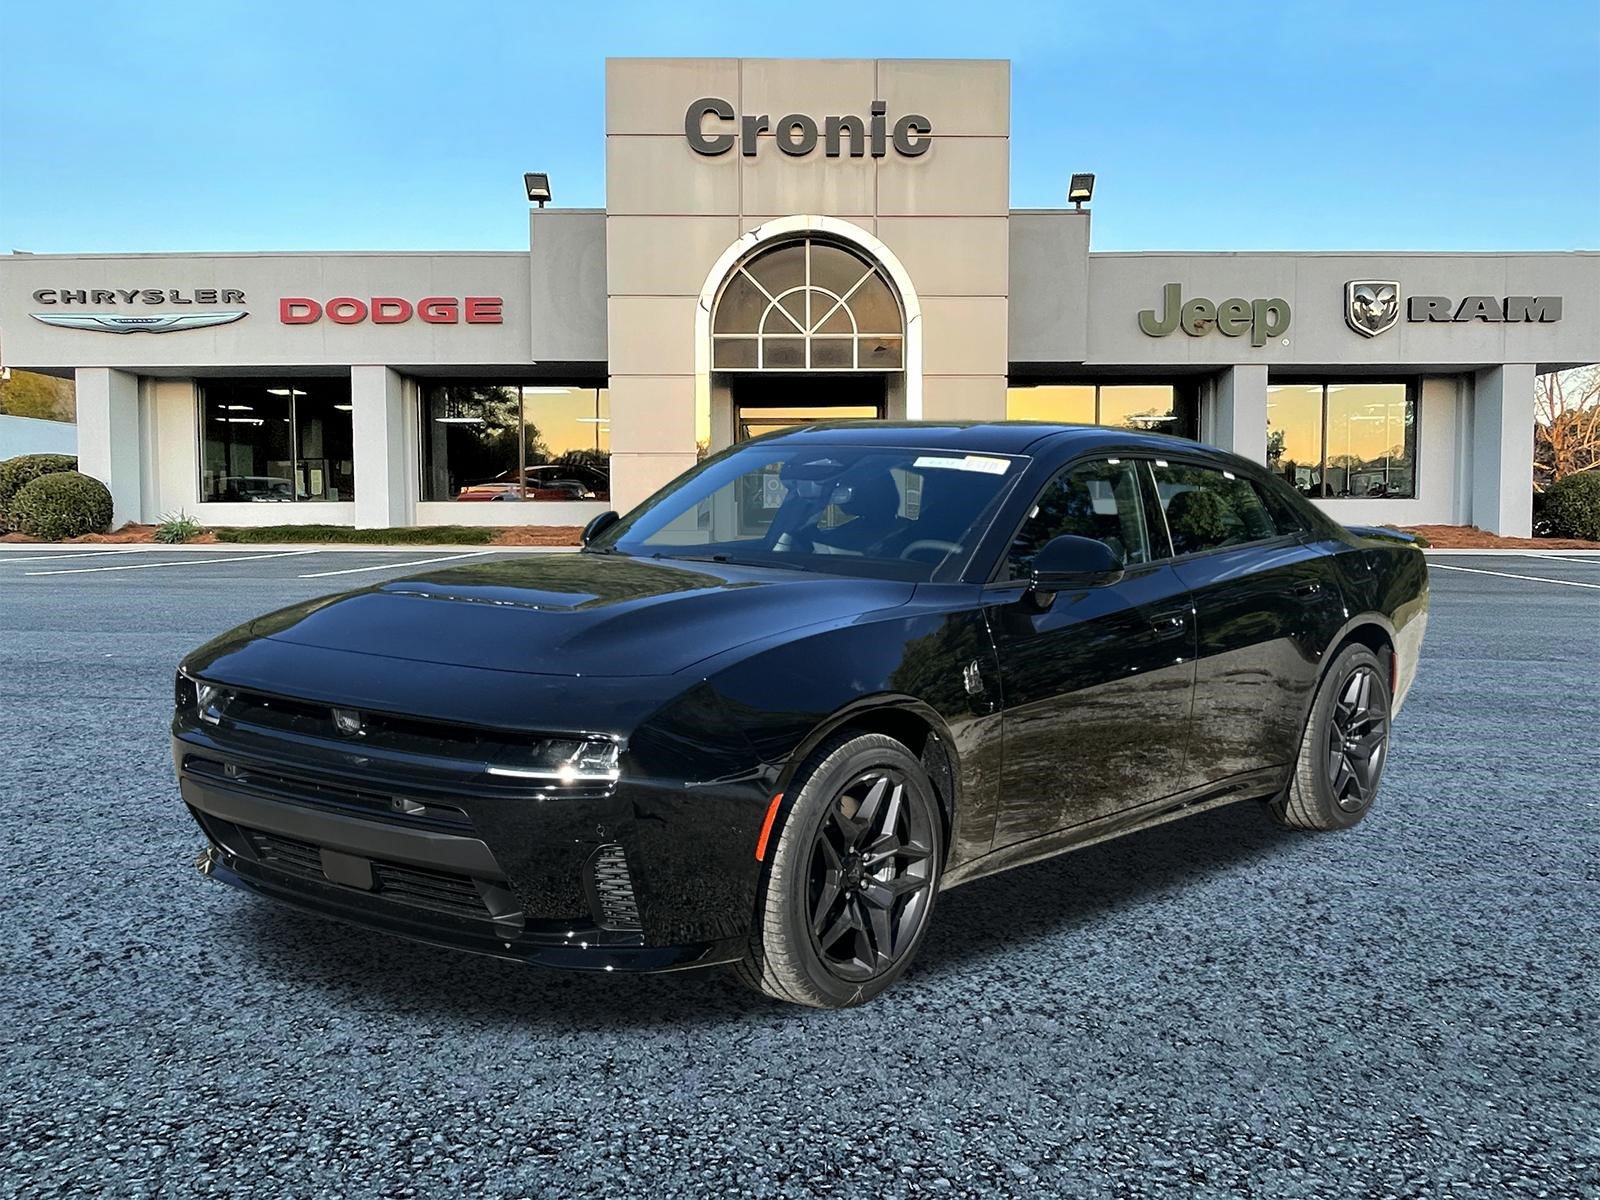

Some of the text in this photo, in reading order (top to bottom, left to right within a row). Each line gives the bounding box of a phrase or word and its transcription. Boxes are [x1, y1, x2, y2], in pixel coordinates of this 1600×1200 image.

[685, 97, 932, 157] Cronic
[32, 288, 248, 305] CHRYSLER
[280, 296, 504, 325] DODGE
[1407, 296, 1563, 323] RAM
[1138, 283, 1291, 347] Jeep
